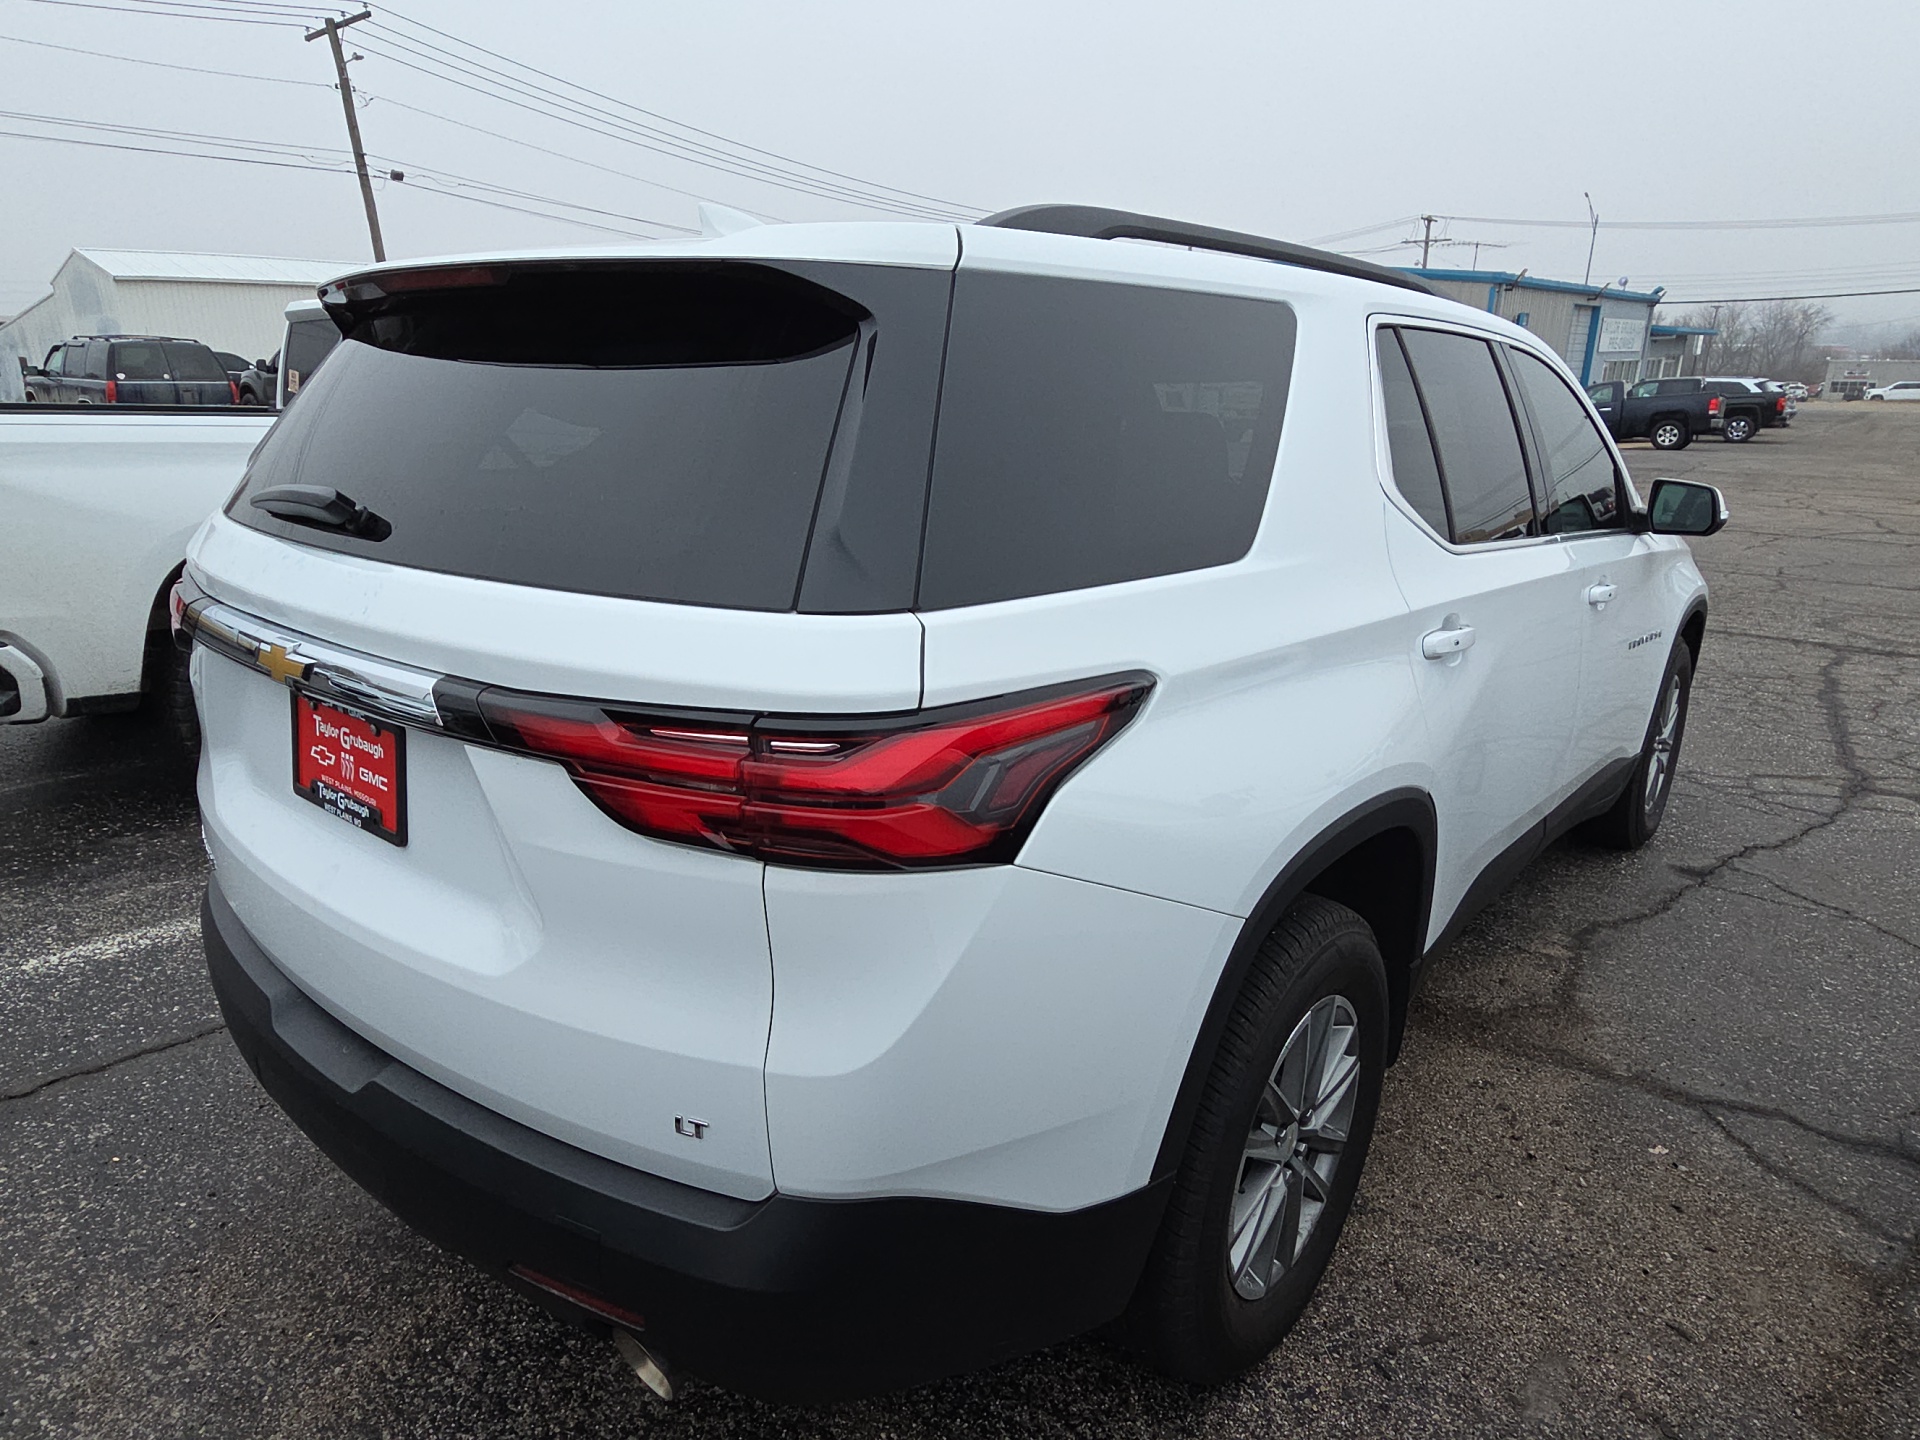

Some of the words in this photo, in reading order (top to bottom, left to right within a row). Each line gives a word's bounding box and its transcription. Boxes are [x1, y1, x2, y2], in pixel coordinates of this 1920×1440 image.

[313, 713, 340, 739] Taylor
[340, 726, 384, 759] Grubaugh
[321, 773, 335, 786] WEST
[359, 766, 388, 792] GMC
[317, 781, 338, 801] Taylor
[337, 792, 369, 818] Grubaugh
[324, 802, 336, 815] WEST
[675, 1114, 710, 1140] LT
